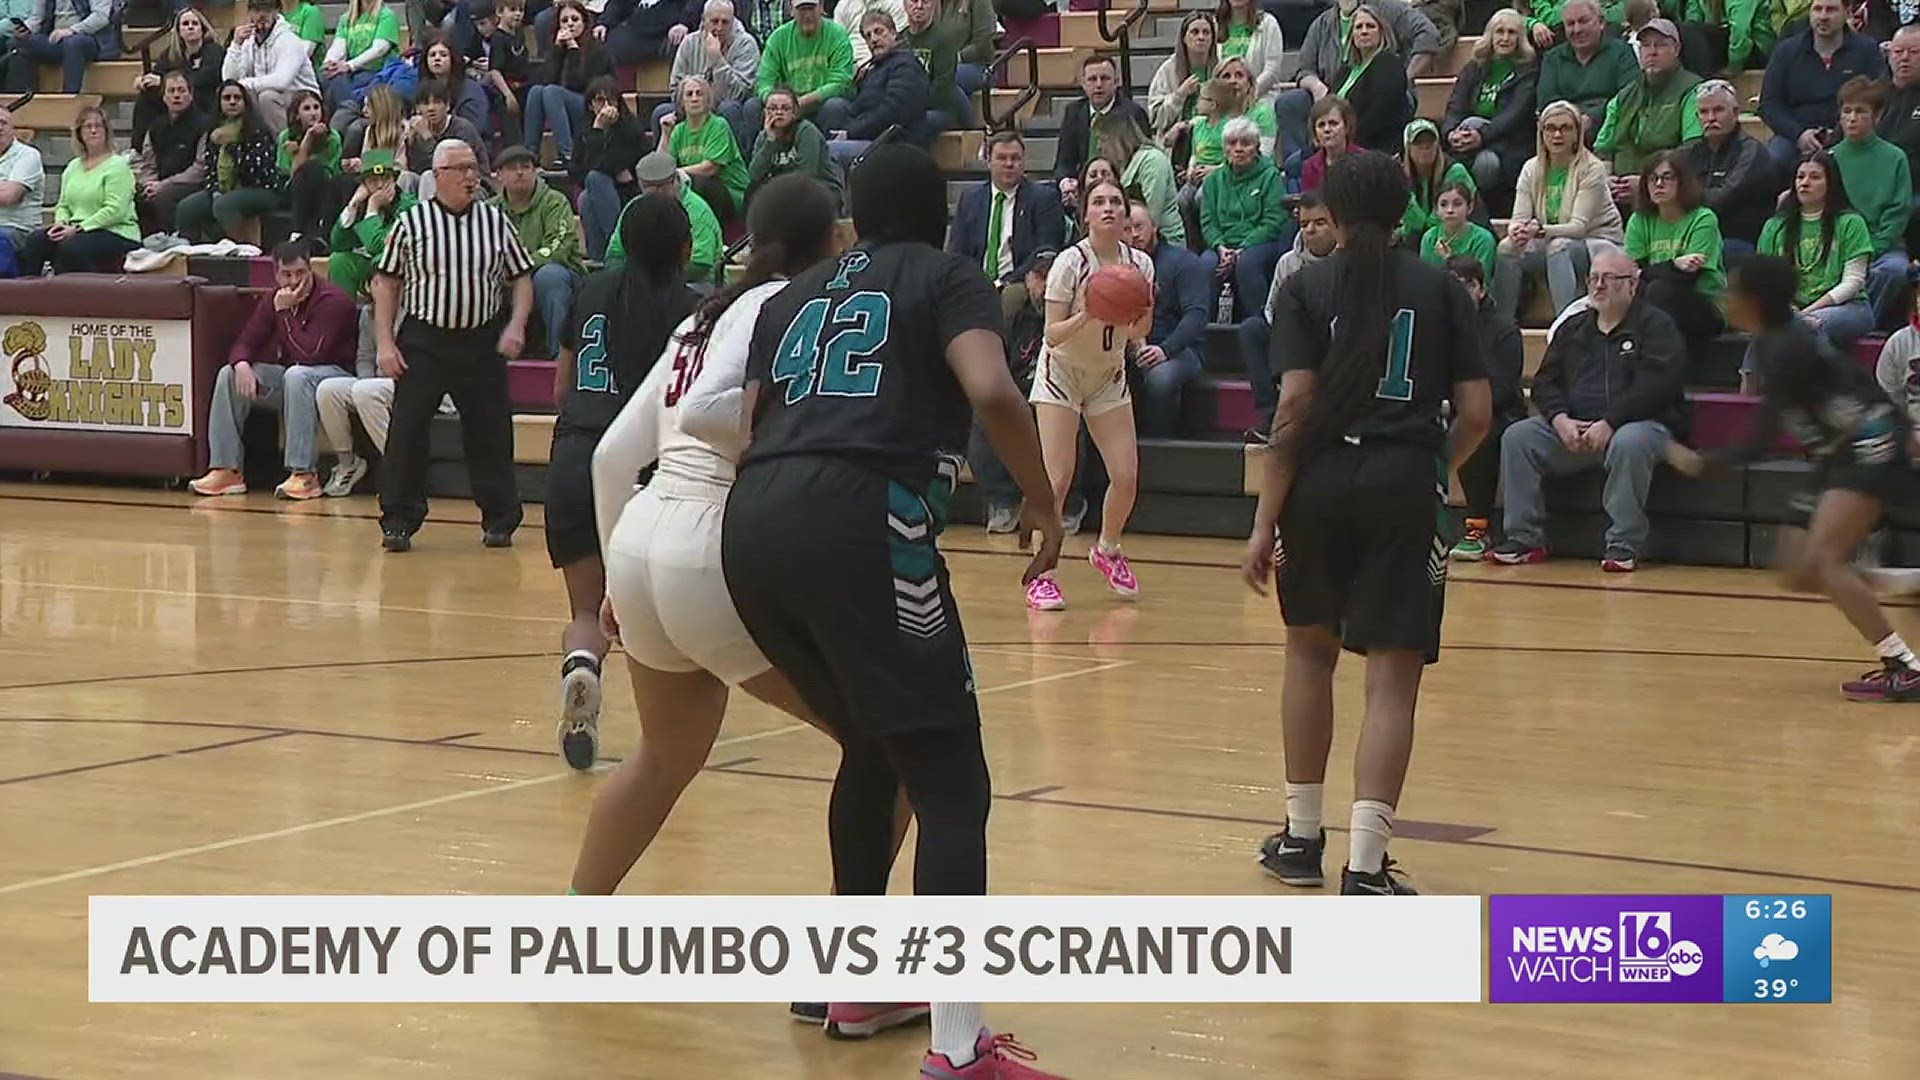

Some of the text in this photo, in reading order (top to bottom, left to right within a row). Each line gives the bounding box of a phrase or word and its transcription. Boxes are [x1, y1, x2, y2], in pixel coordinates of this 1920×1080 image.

[825, 251, 871, 290] P
[71, 324, 153, 338] HOME OF THE
[577, 313, 619, 394] 2
[771, 290, 891, 406] 42
[1102, 325, 1115, 352] 0
[68, 335, 157, 381] LADY
[48, 379, 185, 427] KNIGHTS
